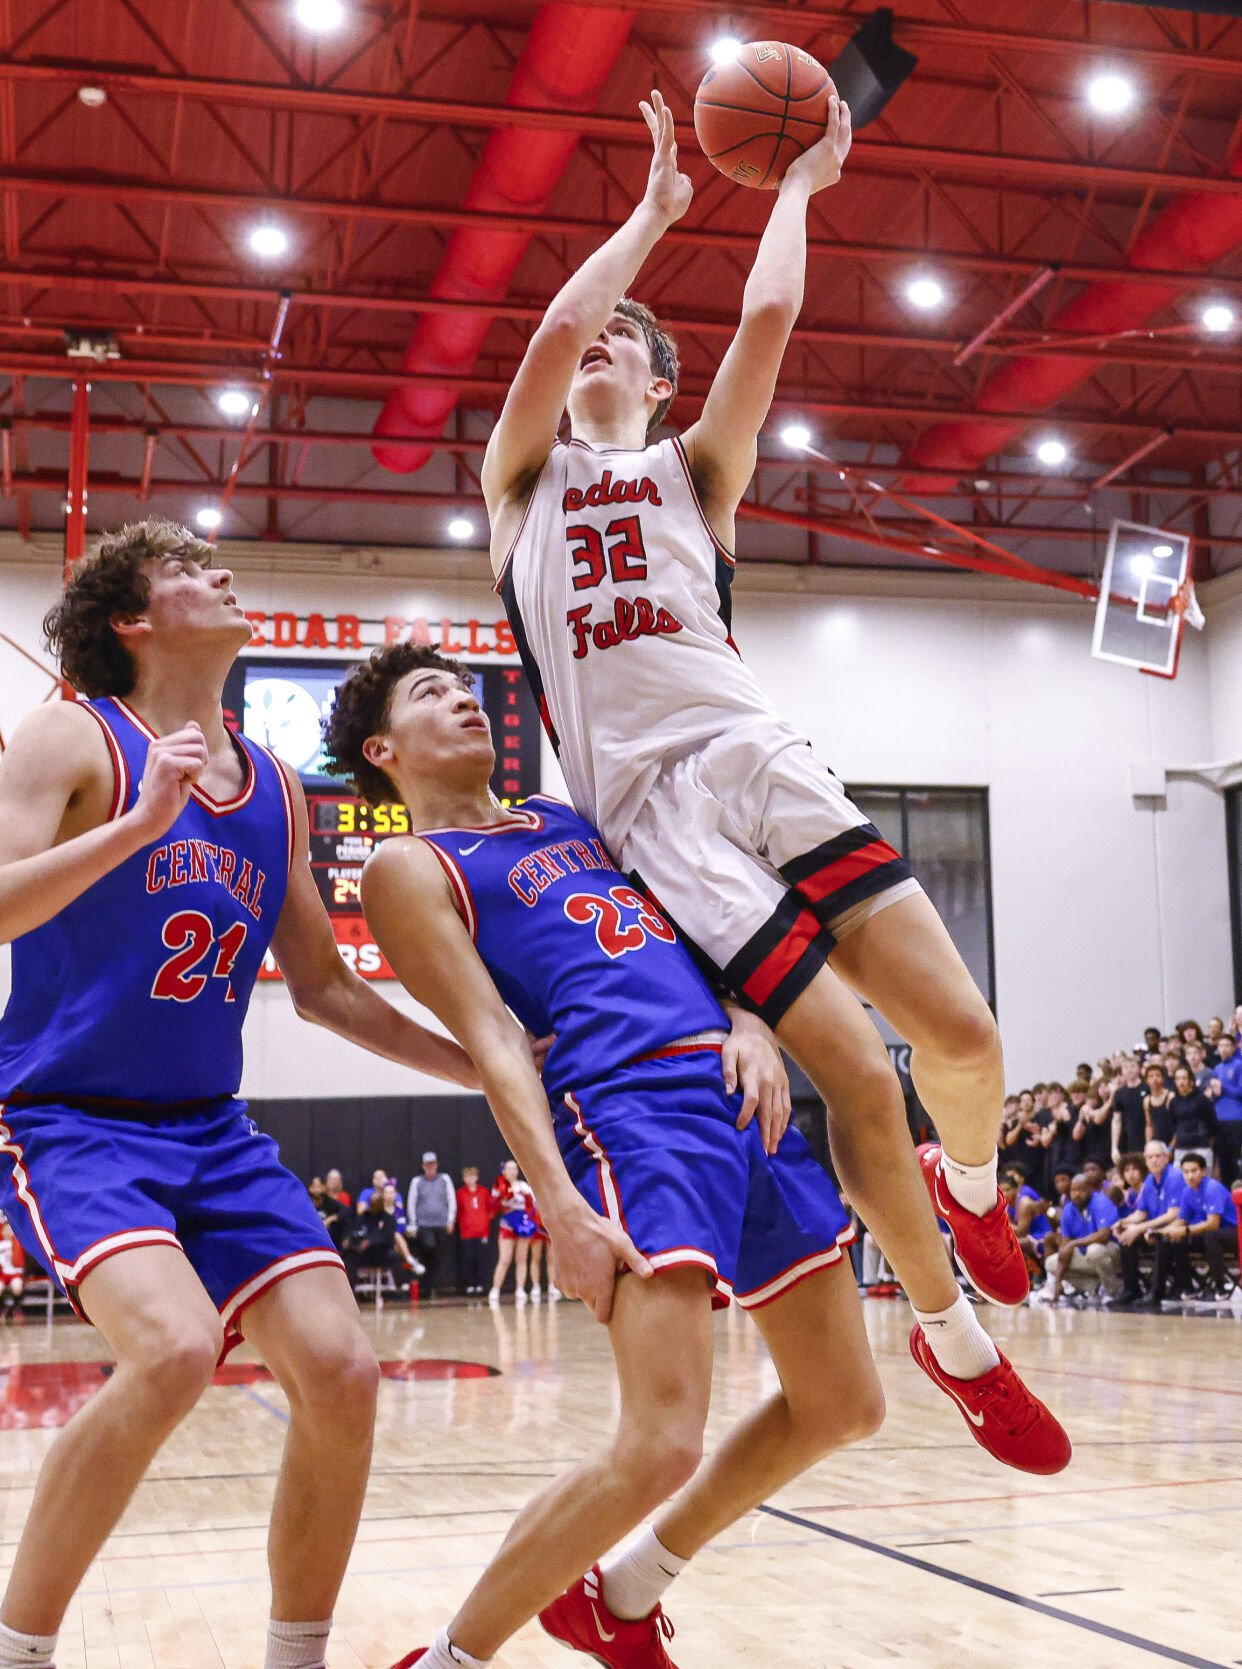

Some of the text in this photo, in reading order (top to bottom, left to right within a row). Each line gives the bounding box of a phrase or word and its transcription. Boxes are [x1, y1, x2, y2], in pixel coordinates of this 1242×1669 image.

[562, 470, 662, 514] edar
[566, 514, 648, 591] 32
[245, 611, 518, 654] EDAR FALLS
[567, 597, 683, 659] Falls
[337, 803, 409, 833] 3:55
[146, 839, 265, 921] CENTRAL
[508, 838, 617, 908] CENTRA
[564, 886, 676, 959] 23
